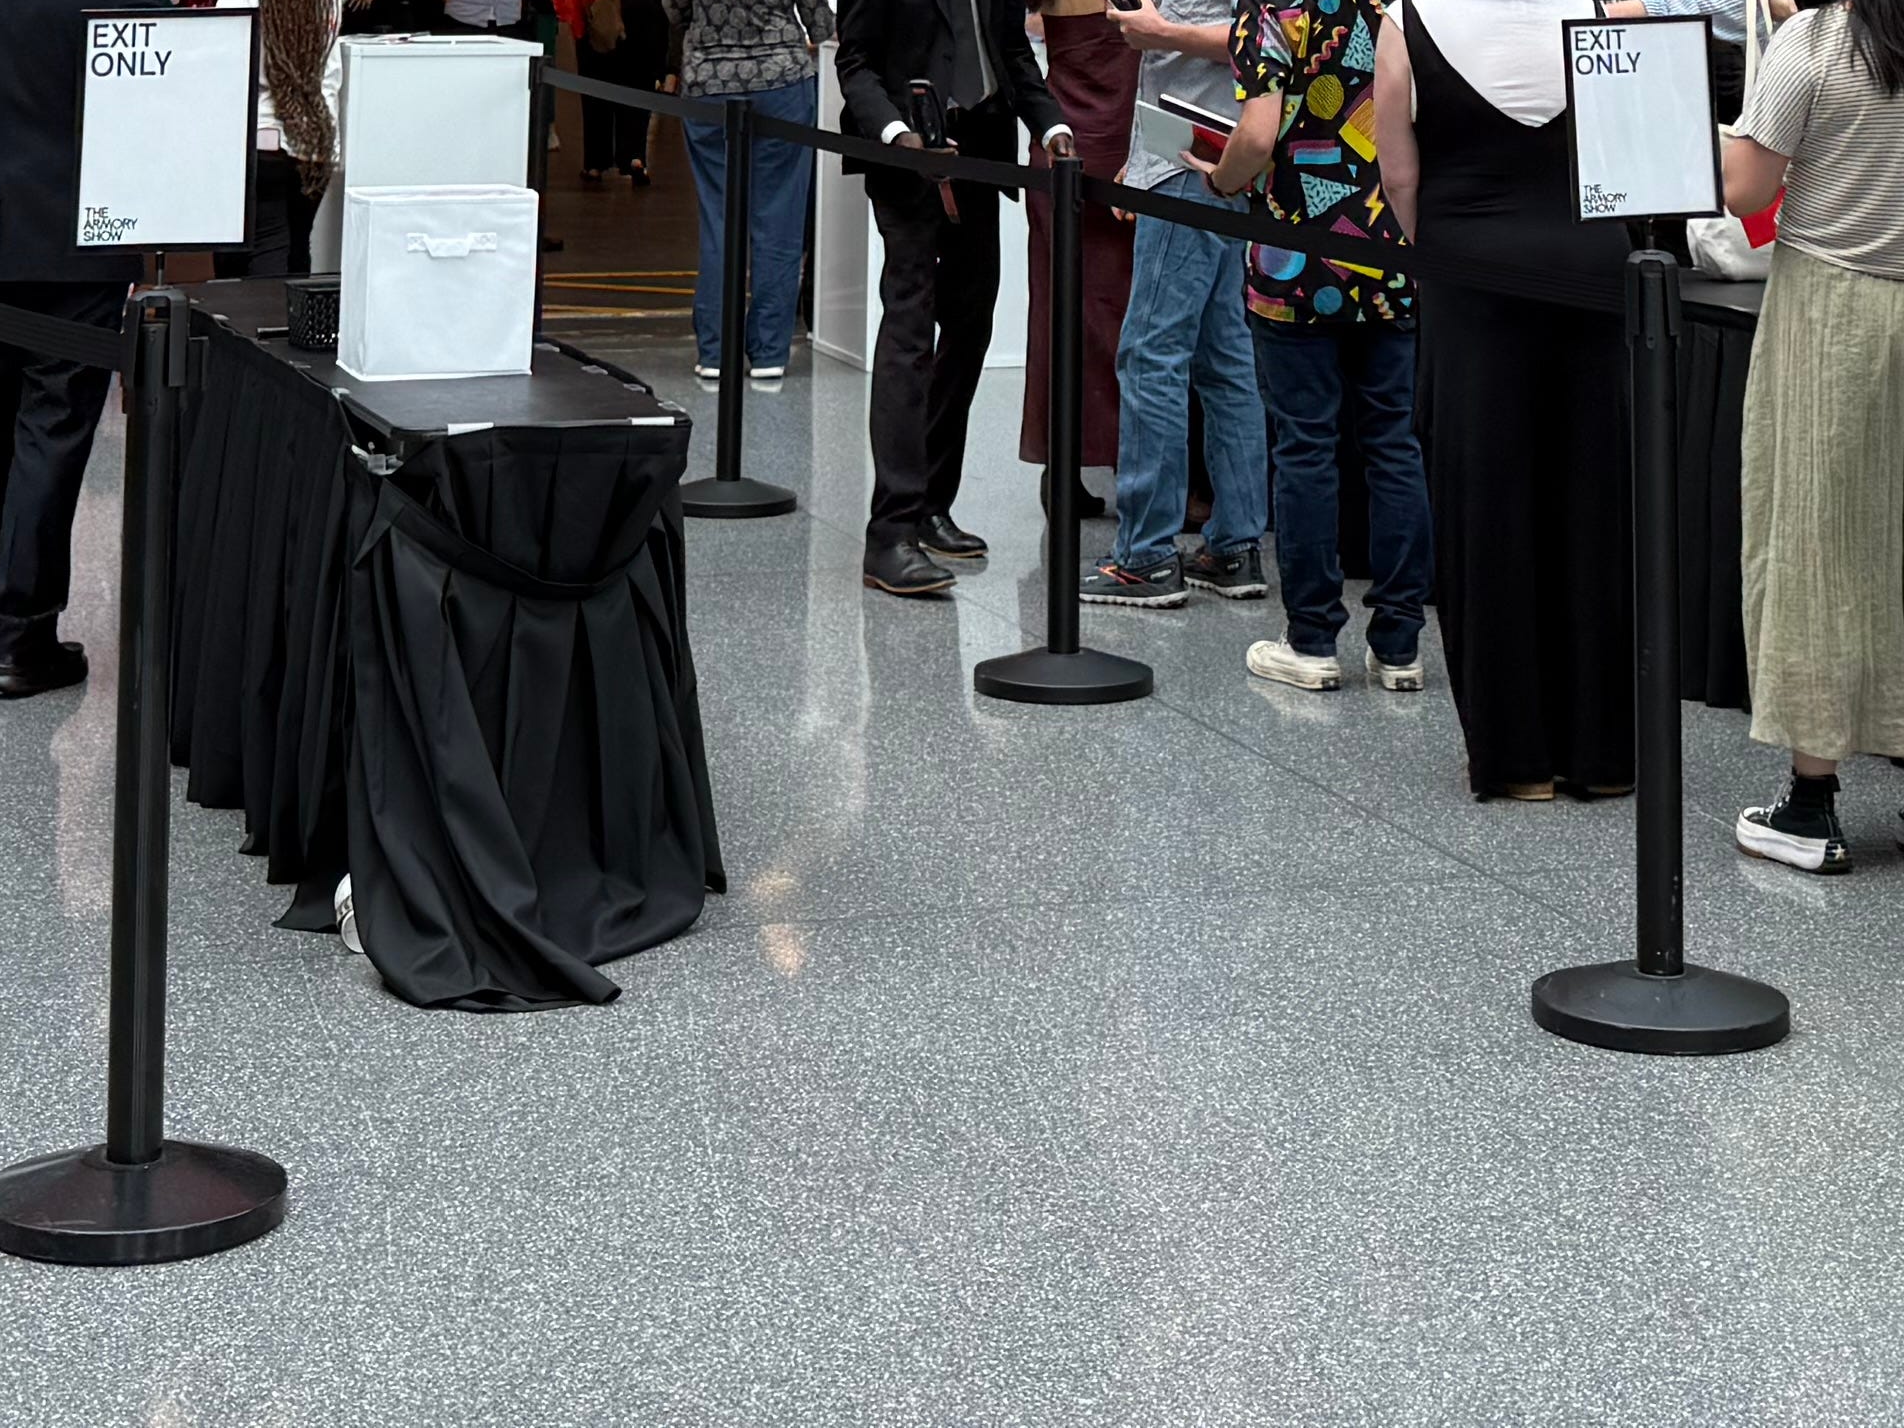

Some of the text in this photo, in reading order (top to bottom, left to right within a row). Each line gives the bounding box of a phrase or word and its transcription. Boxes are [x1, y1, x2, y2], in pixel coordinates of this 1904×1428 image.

[93, 23, 157, 48] EXIT
[1574, 29, 1626, 51] EXIT
[91, 51, 172, 77] ONLY
[1575, 52, 1641, 75] ONLY
[1584, 184, 1603, 194] THE
[1583, 193, 1627, 204] ARMORY
[85, 207, 109, 219] THE
[1584, 203, 1616, 214] SHOW
[83, 218, 138, 231] ARMORY
[83, 230, 123, 242] SHOW
